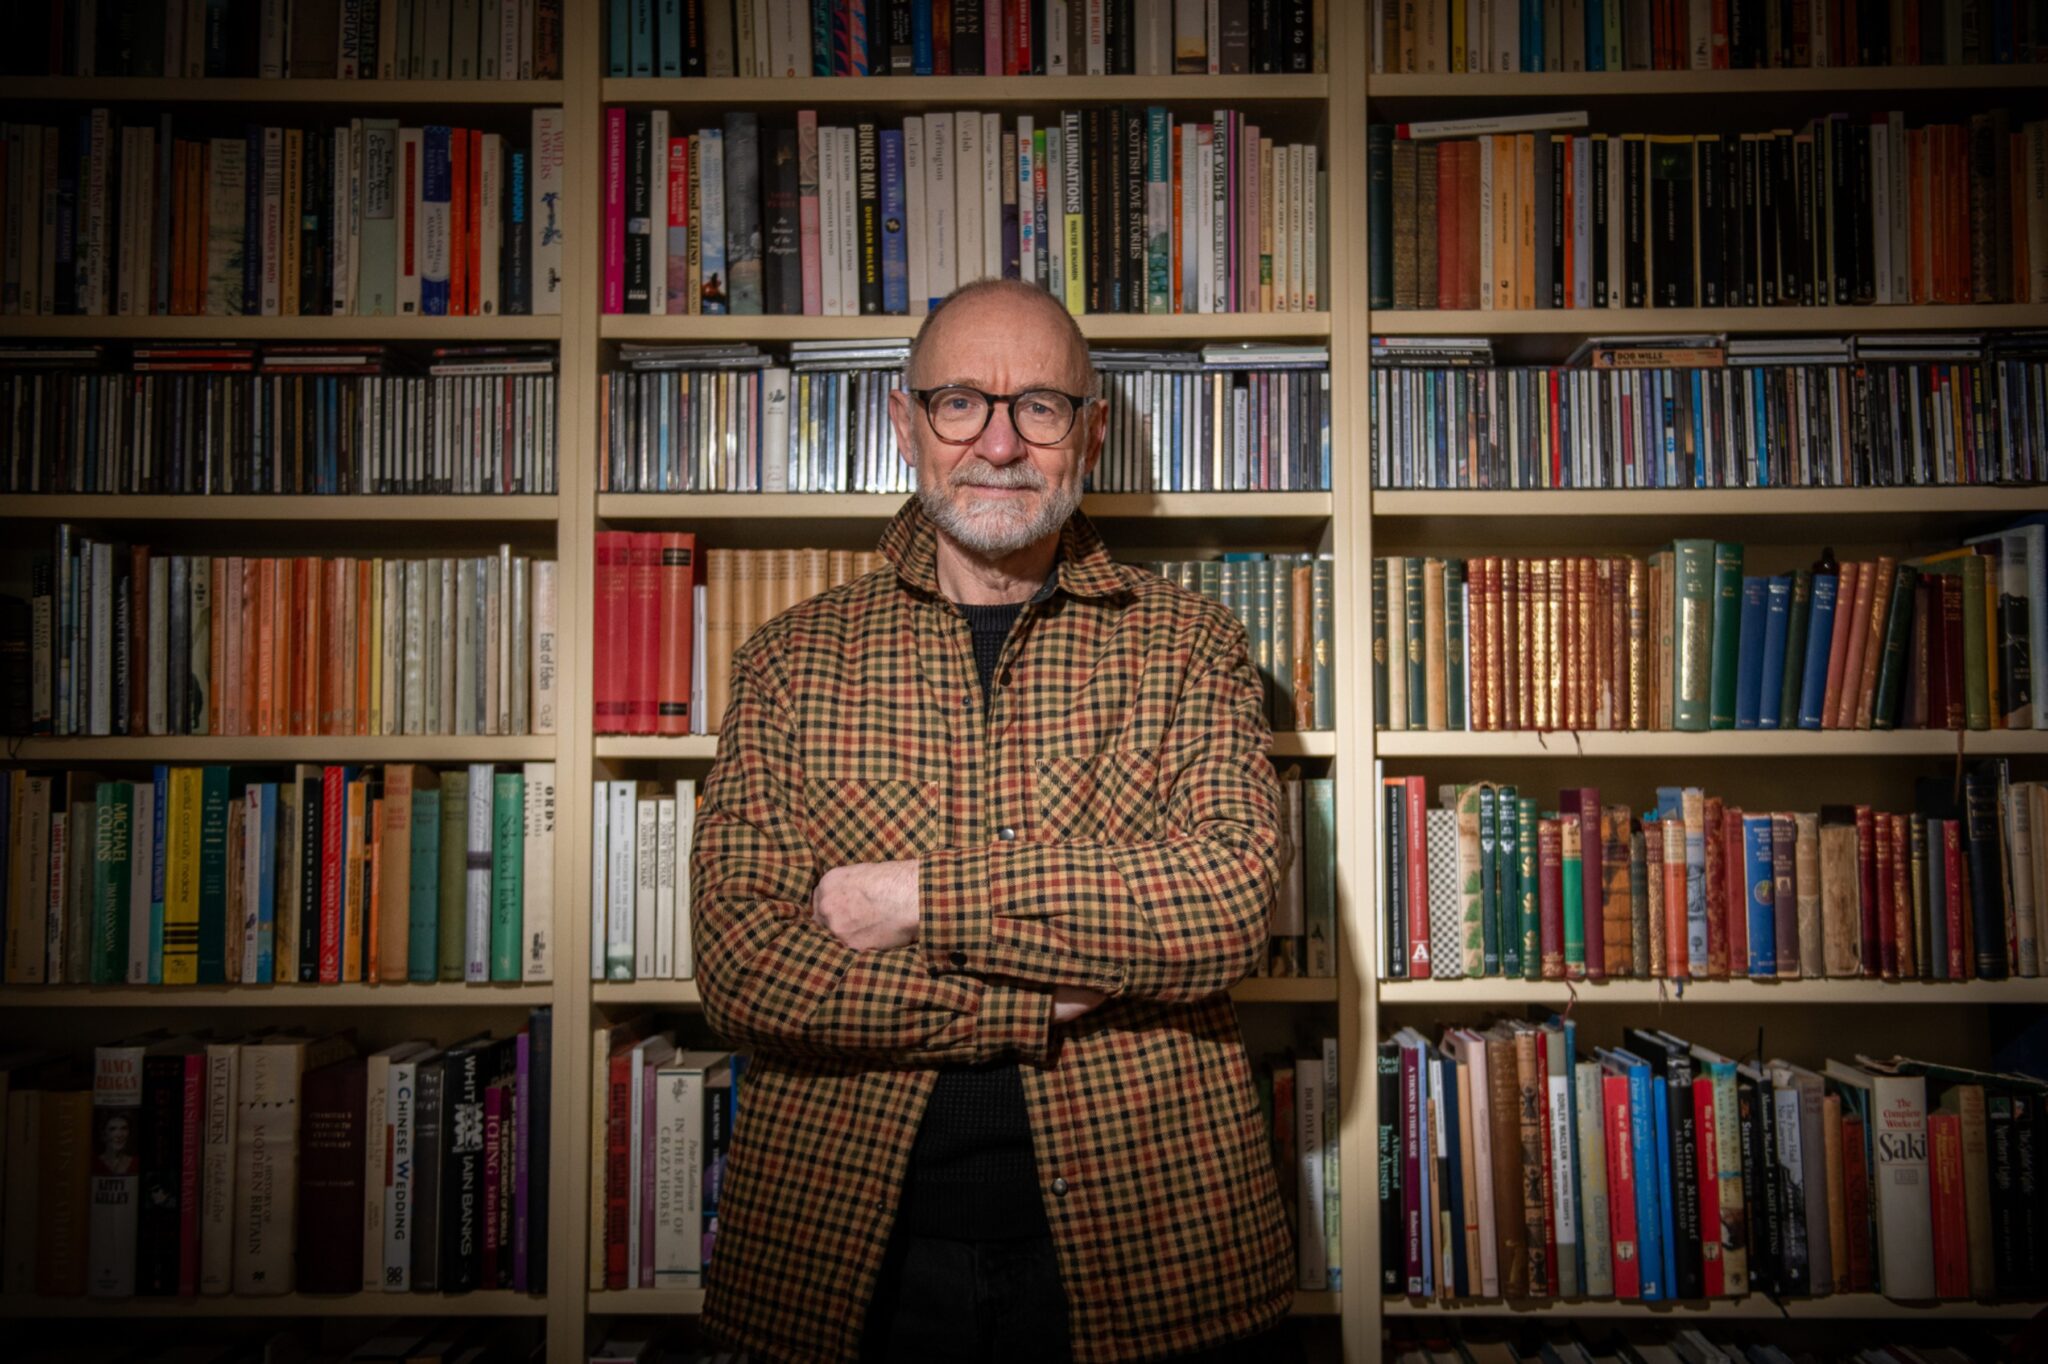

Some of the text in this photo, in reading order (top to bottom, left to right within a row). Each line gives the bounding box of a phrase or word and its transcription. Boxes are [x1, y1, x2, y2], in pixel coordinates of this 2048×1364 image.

[637, 121, 645, 136] The
[1128, 118, 1141, 175] SCOTTISH
[1152, 113, 1163, 182] The Nessman
[1214, 120, 1223, 157] NIGHT
[540, 118, 564, 180] WILD FLOWERS
[859, 124, 876, 199] BUNKER MAN
[933, 122, 945, 180] Torrington
[1034, 152, 1043, 170] me
[1066, 114, 1080, 213] ILLUMINATIONS
[512, 153, 524, 222] IAN RANKIN
[636, 176, 644, 184] of
[887, 164, 895, 183] STAR
[1035, 171, 1046, 192] and
[1215, 162, 1223, 202] VISITS
[690, 141, 700, 266] Stuart Hood CARLINO
[1036, 194, 1044, 211] ma
[1129, 179, 1141, 208] LOVE
[865, 206, 873, 243] DUNCAN
[1131, 213, 1141, 259] STORIES
[267, 263, 275, 283] PATH
[540, 633, 554, 690] East of Eden
[97, 806, 113, 861] COLLINS
[112, 803, 128, 863] MICHAEL
[464, 1055, 477, 1102] WHIT
[1408, 1065, 1415, 1073] A
[1408, 1074, 1416, 1103] THORN
[185, 1075, 198, 1111] TOM
[1304, 1087, 1313, 1111] BOB
[1409, 1104, 1416, 1112] IN
[1557, 1093, 1566, 1122] SORLEY
[1761, 1093, 1772, 1130] Alexander
[1897, 1099, 1912, 1108] The
[211, 1093, 225, 1145] AUDEN
[1305, 1114, 1314, 1152] DYLAN
[1787, 1103, 1797, 1163] The Poor Had
[1883, 1110, 1921, 1118] Complete
[1884, 1120, 1921, 1128] Works of
[394, 1071, 410, 1241] A CHINESE WEDDING
[1409, 1139, 1417, 1160] SIDE
[1558, 1125, 1567, 1160] MACLEAN
[1675, 1130, 1684, 1177] ALISTAIR
[1778, 1117, 1787, 1156] Lawyers
[1879, 1133, 1926, 1161] Saki
[659, 1126, 671, 1227] CRAZY HORSE
[673, 1118, 685, 1236] IN THE SPIRIT OF
[1379, 1124, 1392, 1200] Jane Austen
[1392, 1134, 1401, 1189] A Portrait of
[1742, 1122, 1752, 1197] SILENT WEAVER
[184, 1172, 196, 1215] DIARY
[249, 1124, 265, 1255] MODERN BRITAIN
[263, 1165, 272, 1209] HISTORY
[1683, 1119, 1697, 1240] No Great Mischief
[1767, 1183, 1776, 1214] LIGHT
[264, 1212, 272, 1223] OF
[460, 1155, 473, 1256] IAIN BANKS
[500, 1199, 508, 1208] OF
[1410, 1210, 1418, 1236] Robert
[1768, 1216, 1778, 1255] LIFTING
